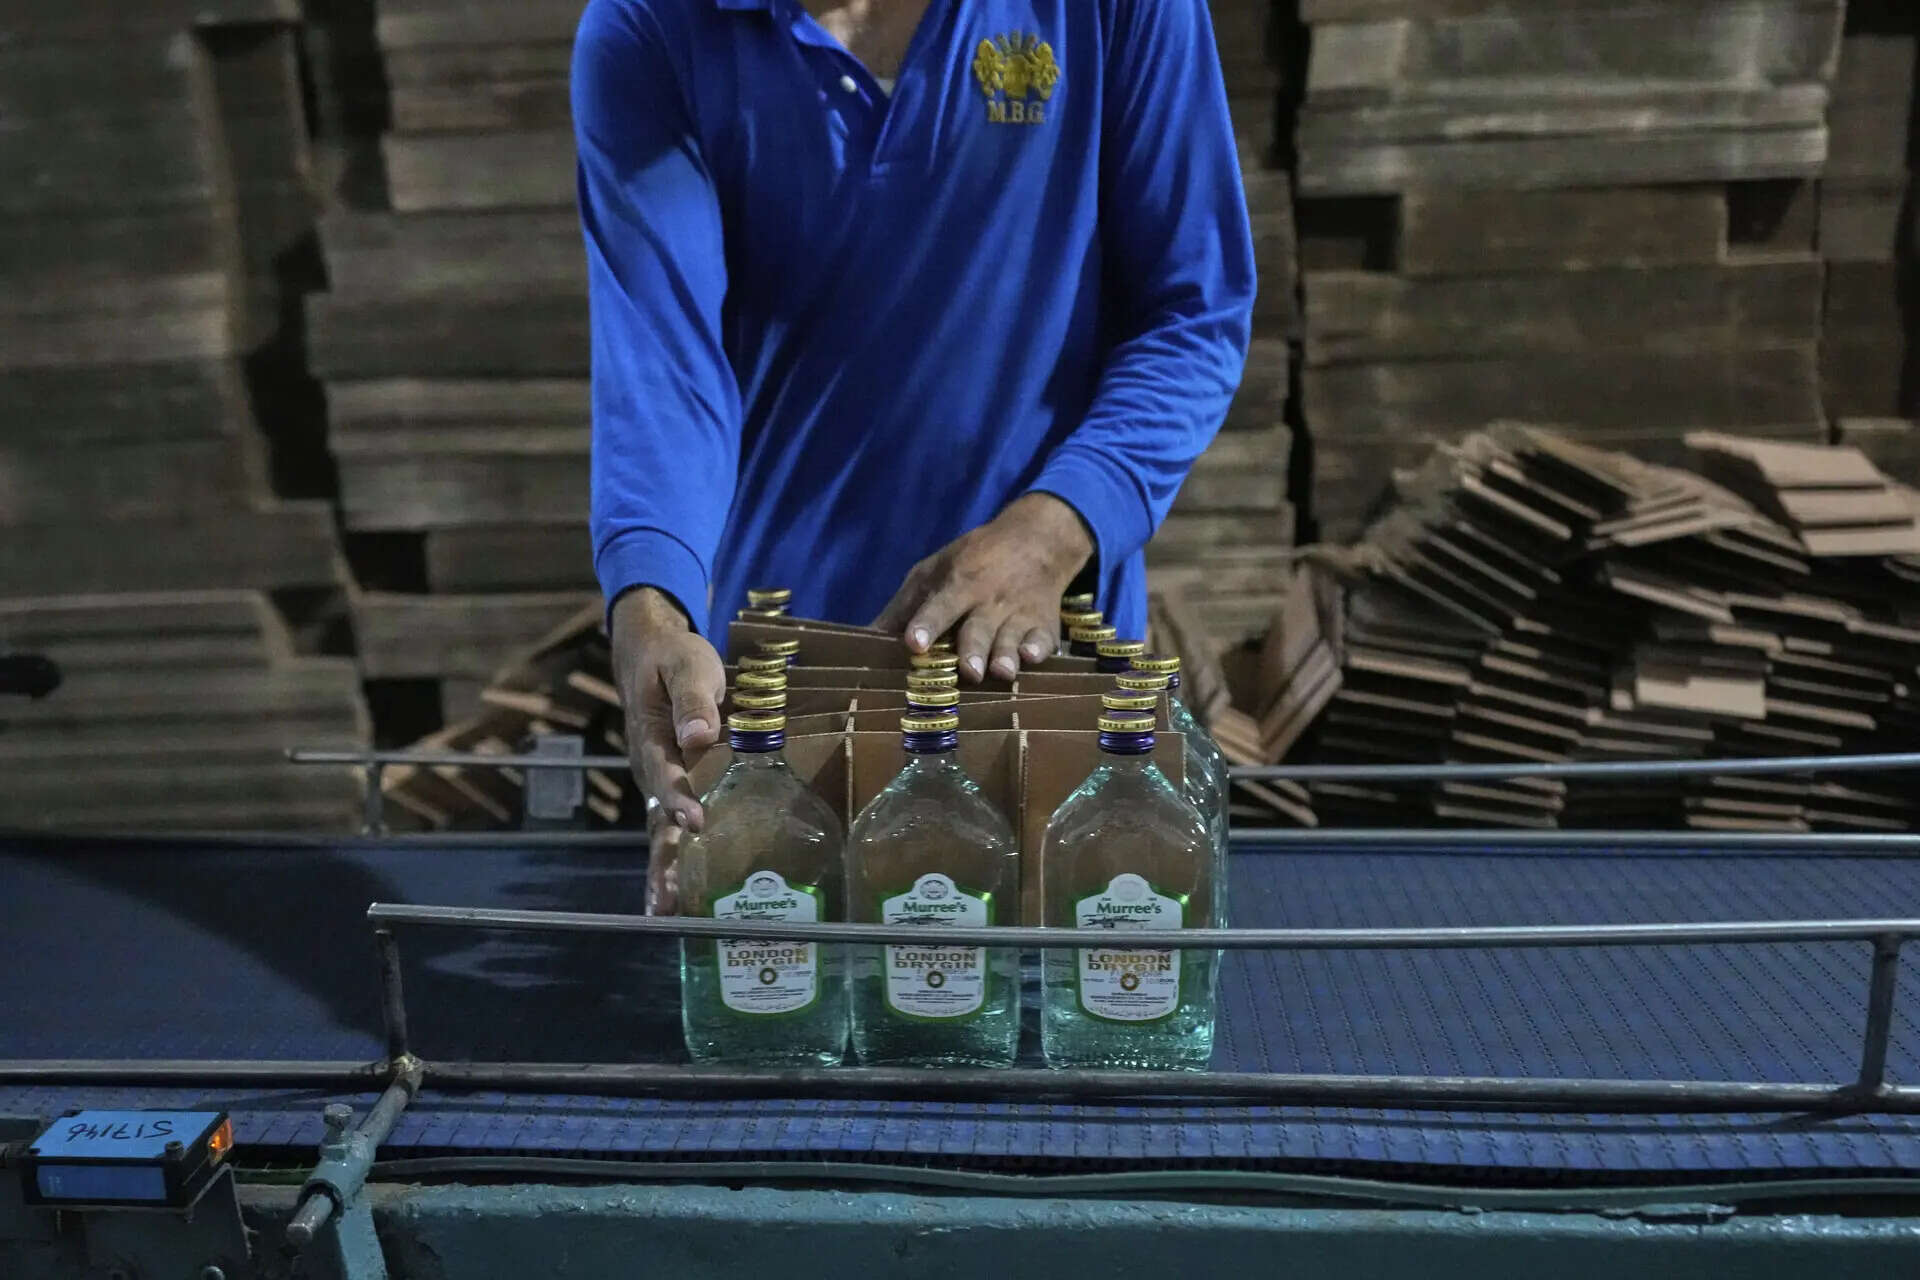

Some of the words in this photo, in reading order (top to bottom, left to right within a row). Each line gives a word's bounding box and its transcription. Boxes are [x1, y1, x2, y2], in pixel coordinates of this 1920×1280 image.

[734, 899, 797, 911] Murree's
[903, 901, 968, 912] Murree's
[1096, 902, 1162, 914] Murree's
[727, 949, 809, 960] LONDON
[895, 952, 976, 962] LONDON
[1088, 954, 1171, 963] LONDON
